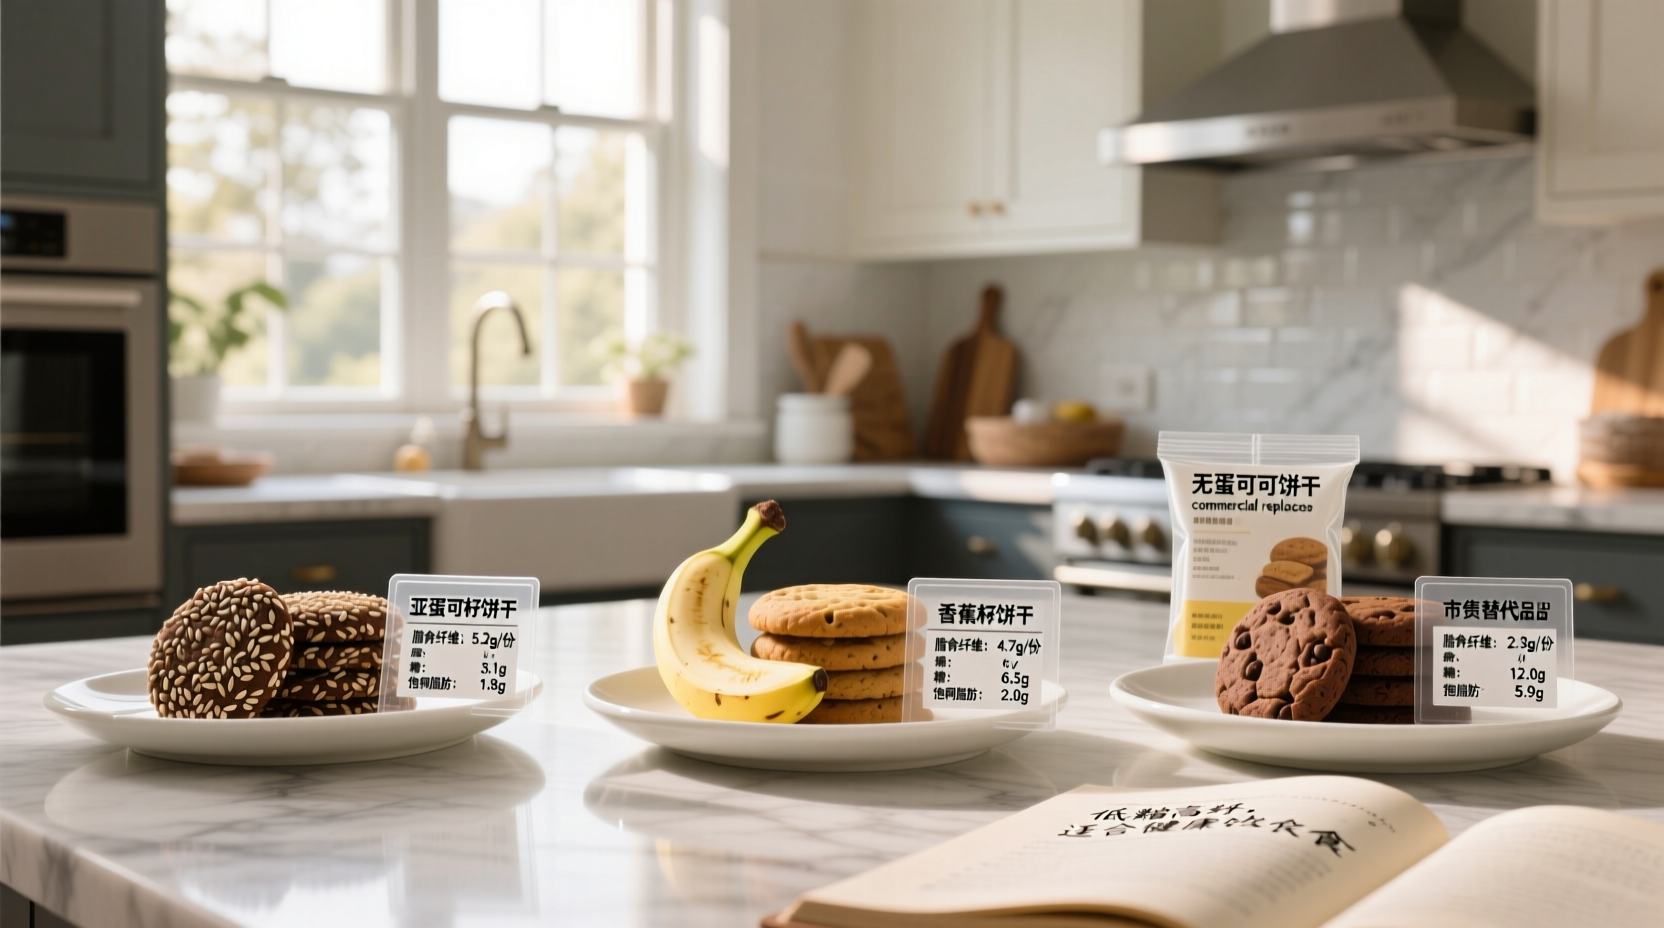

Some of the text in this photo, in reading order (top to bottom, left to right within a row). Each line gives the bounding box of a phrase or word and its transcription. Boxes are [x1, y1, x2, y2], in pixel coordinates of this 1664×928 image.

[1192, 473, 1321, 497] 无蛋可可饼干
[1001, 672, 1029, 688] 6.5g
[1511, 667, 1545, 683] 12.0g
[480, 679, 506, 694] 1.8g
[1514, 685, 1544, 702] 5.9g
[1001, 689, 1029, 705] 2.0g
